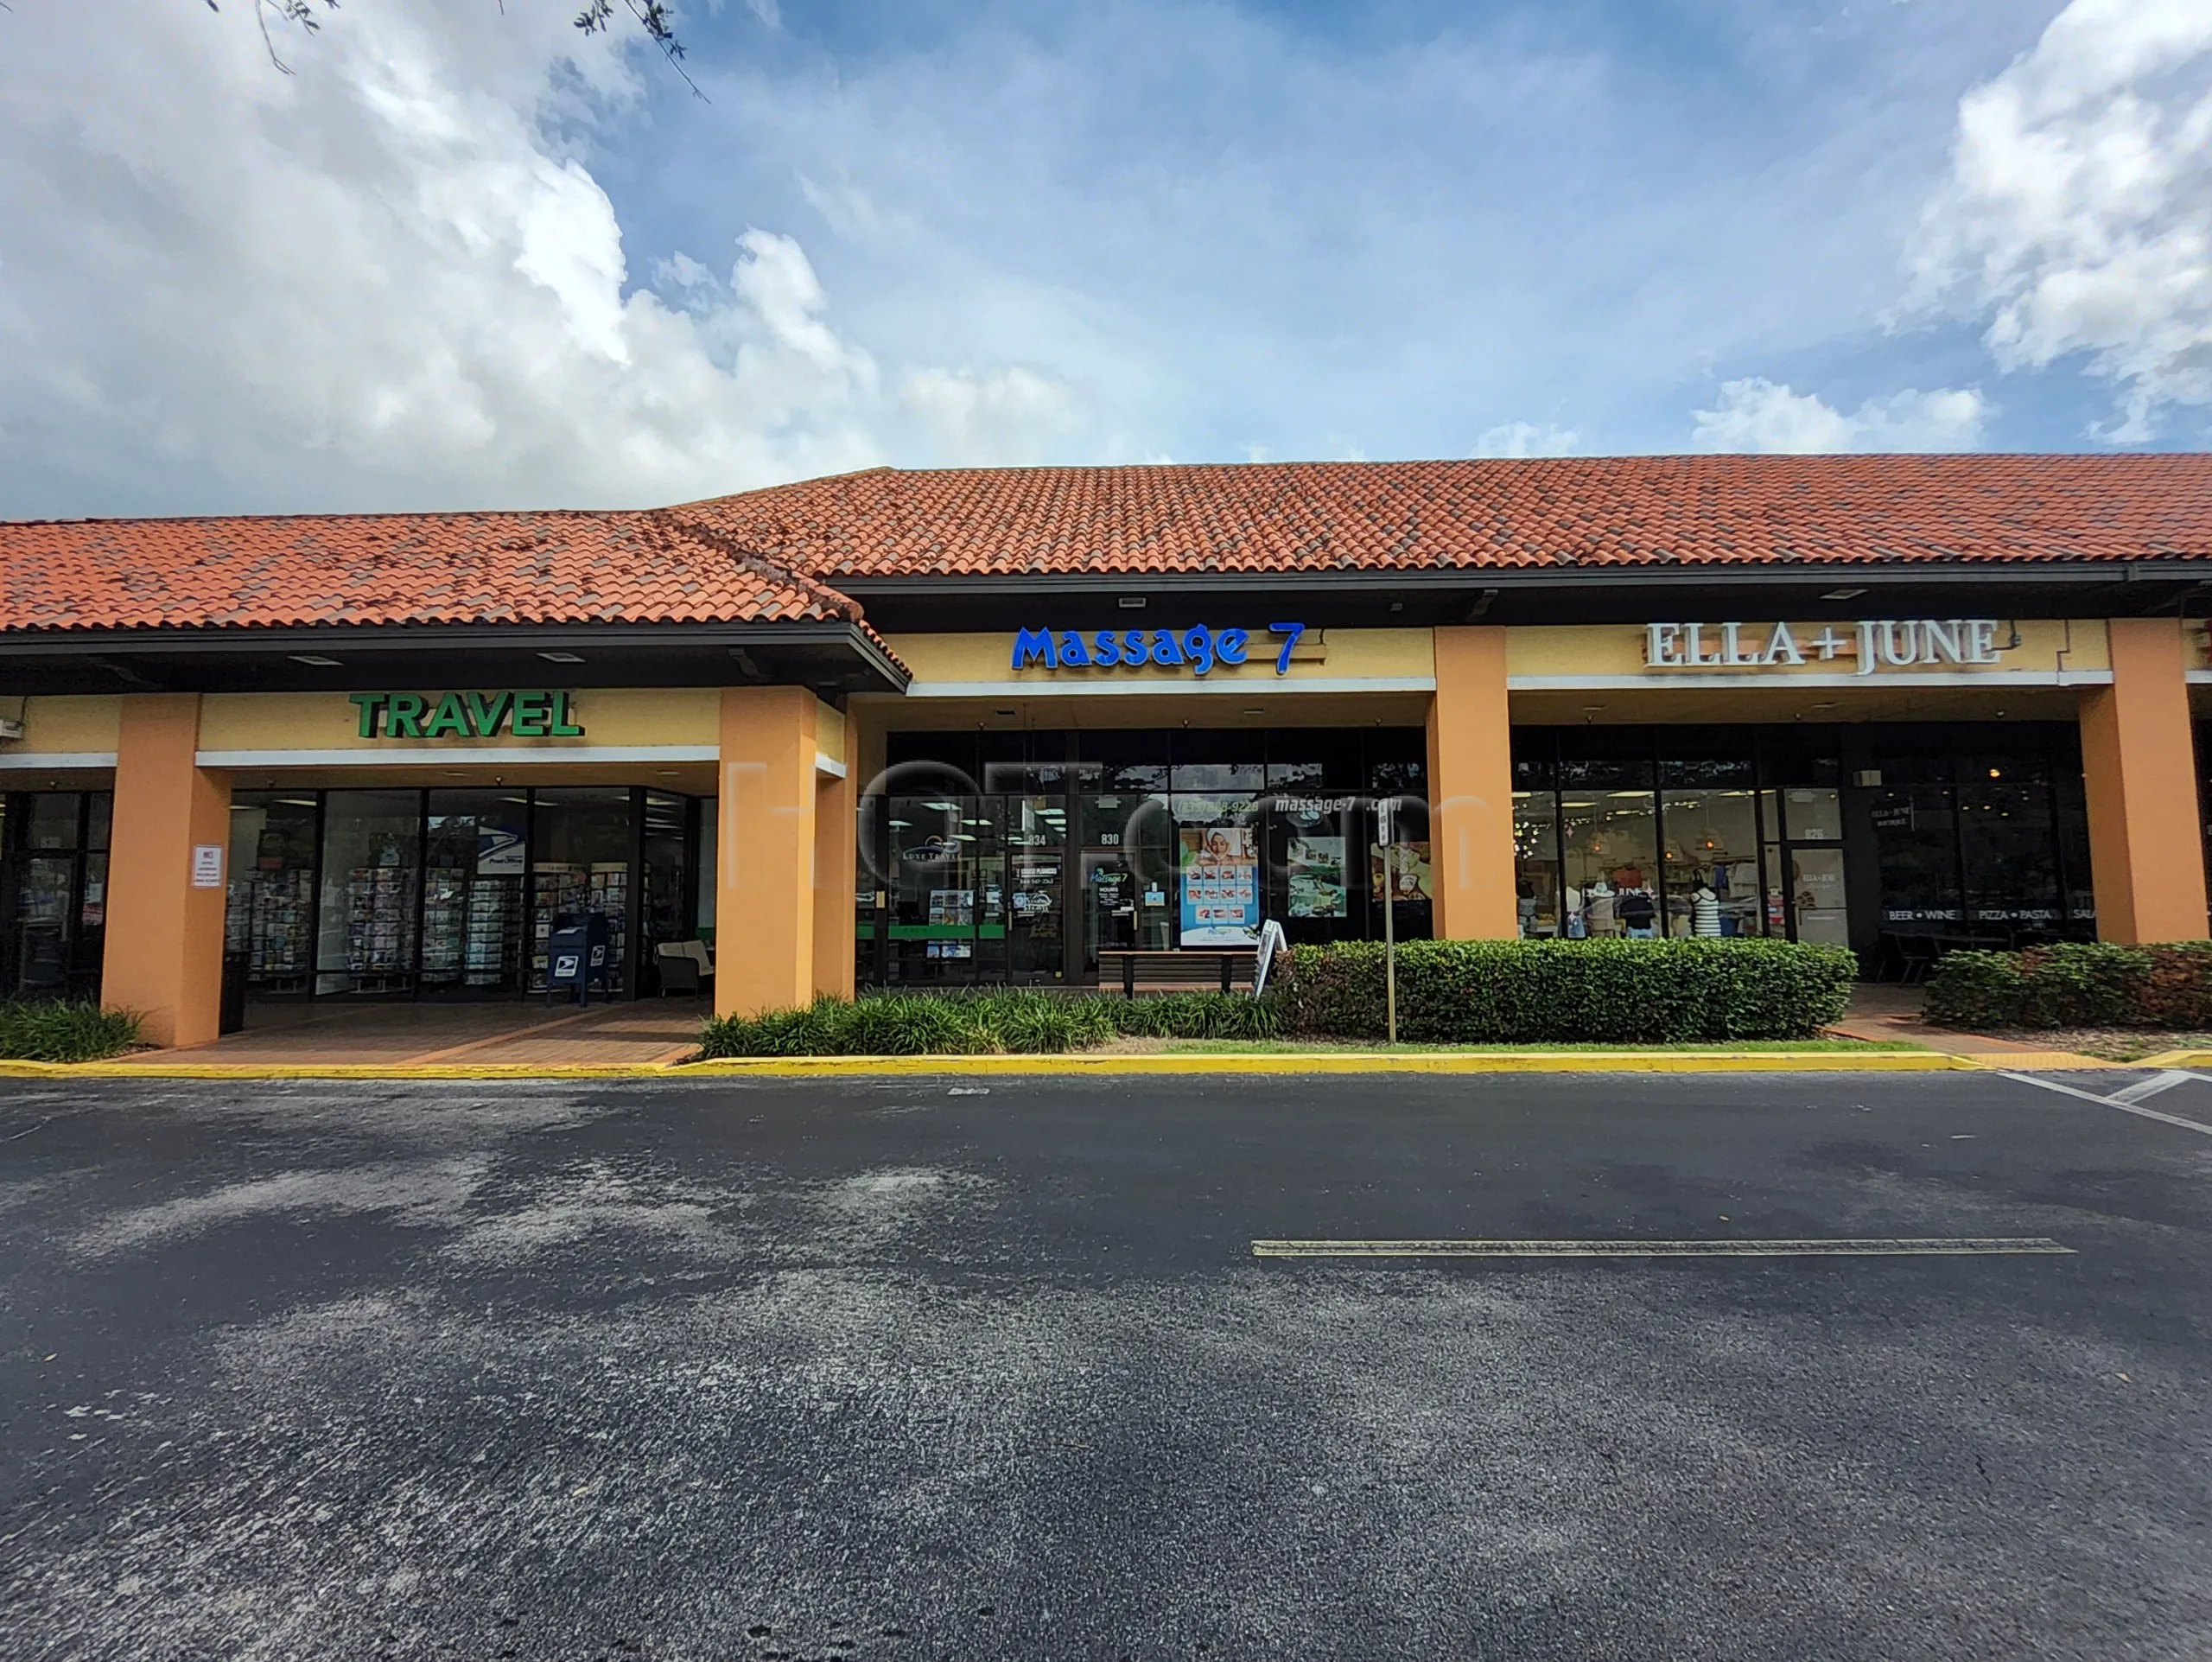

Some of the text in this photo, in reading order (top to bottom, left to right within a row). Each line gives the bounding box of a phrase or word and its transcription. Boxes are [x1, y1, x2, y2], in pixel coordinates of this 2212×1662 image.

[1012, 622, 1305, 675] Massage 7
[1643, 620, 2002, 677] ELLA + JUNE
[349, 691, 586, 738] TRAVEL
[1274, 796, 1402, 814] massage-7 .cm
[1028, 834, 1046, 846] 834
[1101, 833, 1120, 845] 830
[1090, 872, 1128, 886] Massage 7
[1890, 909, 1956, 920] BEER WINE
[1979, 909, 2051, 920] PIZZA PASTA
